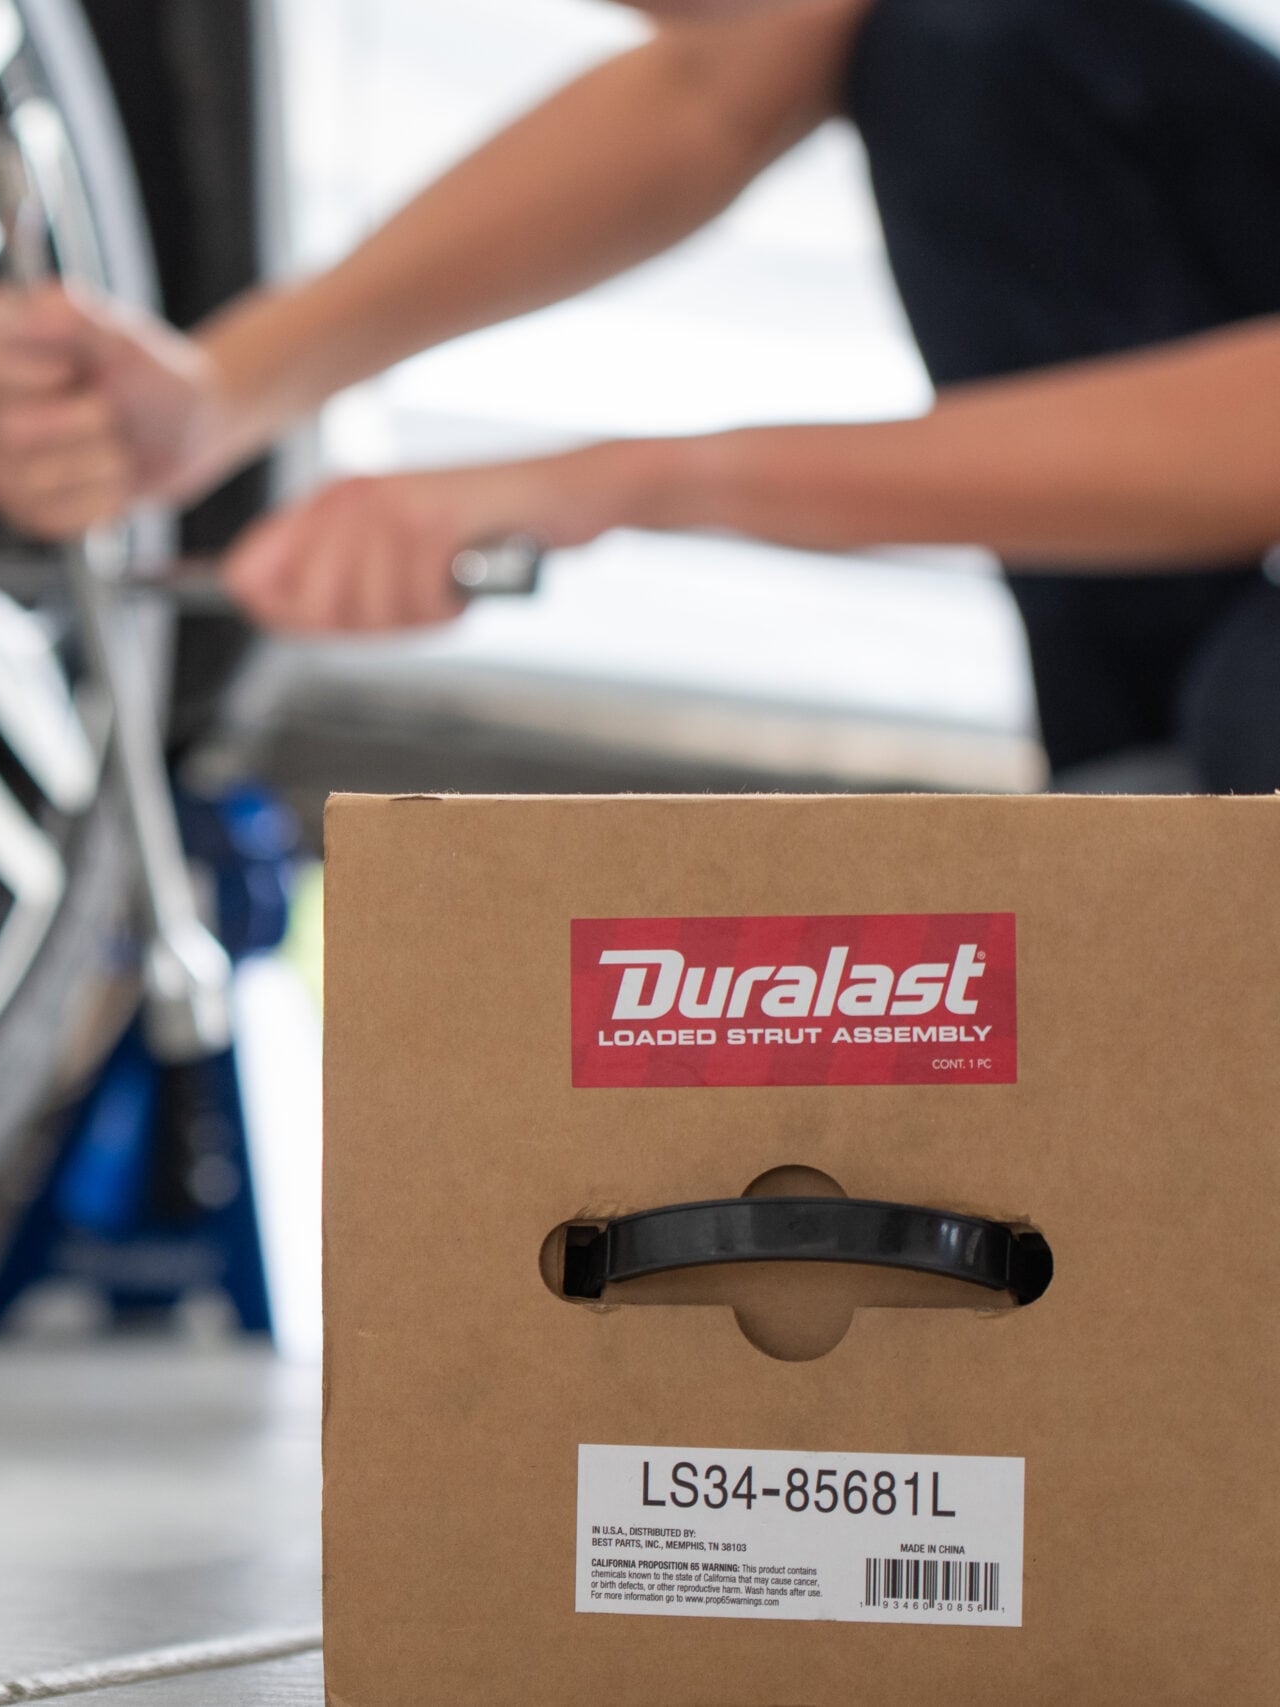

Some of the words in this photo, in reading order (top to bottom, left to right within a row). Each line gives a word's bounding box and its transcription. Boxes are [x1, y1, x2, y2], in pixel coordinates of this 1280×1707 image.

[599, 1030, 716, 1046] LOADED
[727, 1028, 821, 1044] STRUT
[832, 1026, 992, 1043] ASSEMBLY
[932, 1059, 965, 1069] CONT.
[978, 1059, 991, 1069] PC
[642, 1461, 956, 1517] LS34-85681L
[592, 1526, 600, 1534] IN
[602, 1527, 627, 1536] U.S.A.,
[630, 1528, 681, 1537] DISTRIBUTED
[592, 1538, 613, 1546] BEST
[615, 1539, 643, 1548] PARTS,
[645, 1541, 663, 1549] INC.,
[666, 1541, 706, 1551] MEMPHIS,
[709, 1543, 719, 1551] TN
[722, 1543, 747, 1552] 38103
[900, 1544, 924, 1553] MADE
[928, 1545, 936, 1553] IN
[939, 1545, 965, 1554] CHINA
[592, 1559, 635, 1567] CALIFORNIA
[639, 1560, 688, 1569] PROPOSITION
[691, 1562, 699, 1570] 65
[702, 1563, 740, 1572] WARNING:
[742, 1565, 757, 1573] This
[759, 1565, 785, 1575] product
[787, 1567, 816, 1575] contains
[591, 1569, 626, 1578] chemicals
[628, 1571, 651, 1580] known
[663, 1572, 673, 1580] the
[675, 1573, 693, 1581] state
[704, 1574, 736, 1583] California
[738, 1575, 752, 1583] that
[754, 1578, 769, 1586] may
[794, 1578, 819, 1587] cancer,
[600, 1580, 616, 1589] birth
[619, 1581, 645, 1591] defects,
[657, 1583, 674, 1591] other
[677, 1584, 720, 1594] reproductive
[722, 1585, 742, 1594] harm.
[745, 1586, 764, 1594] Wash
[766, 1587, 787, 1595] hands
[790, 1588, 805, 1596] after
[591, 1591, 601, 1599] For
[624, 1592, 663, 1601] information
[666, 1595, 674, 1603] go
[685, 1596, 779, 1607] www.prop65warnings.com
